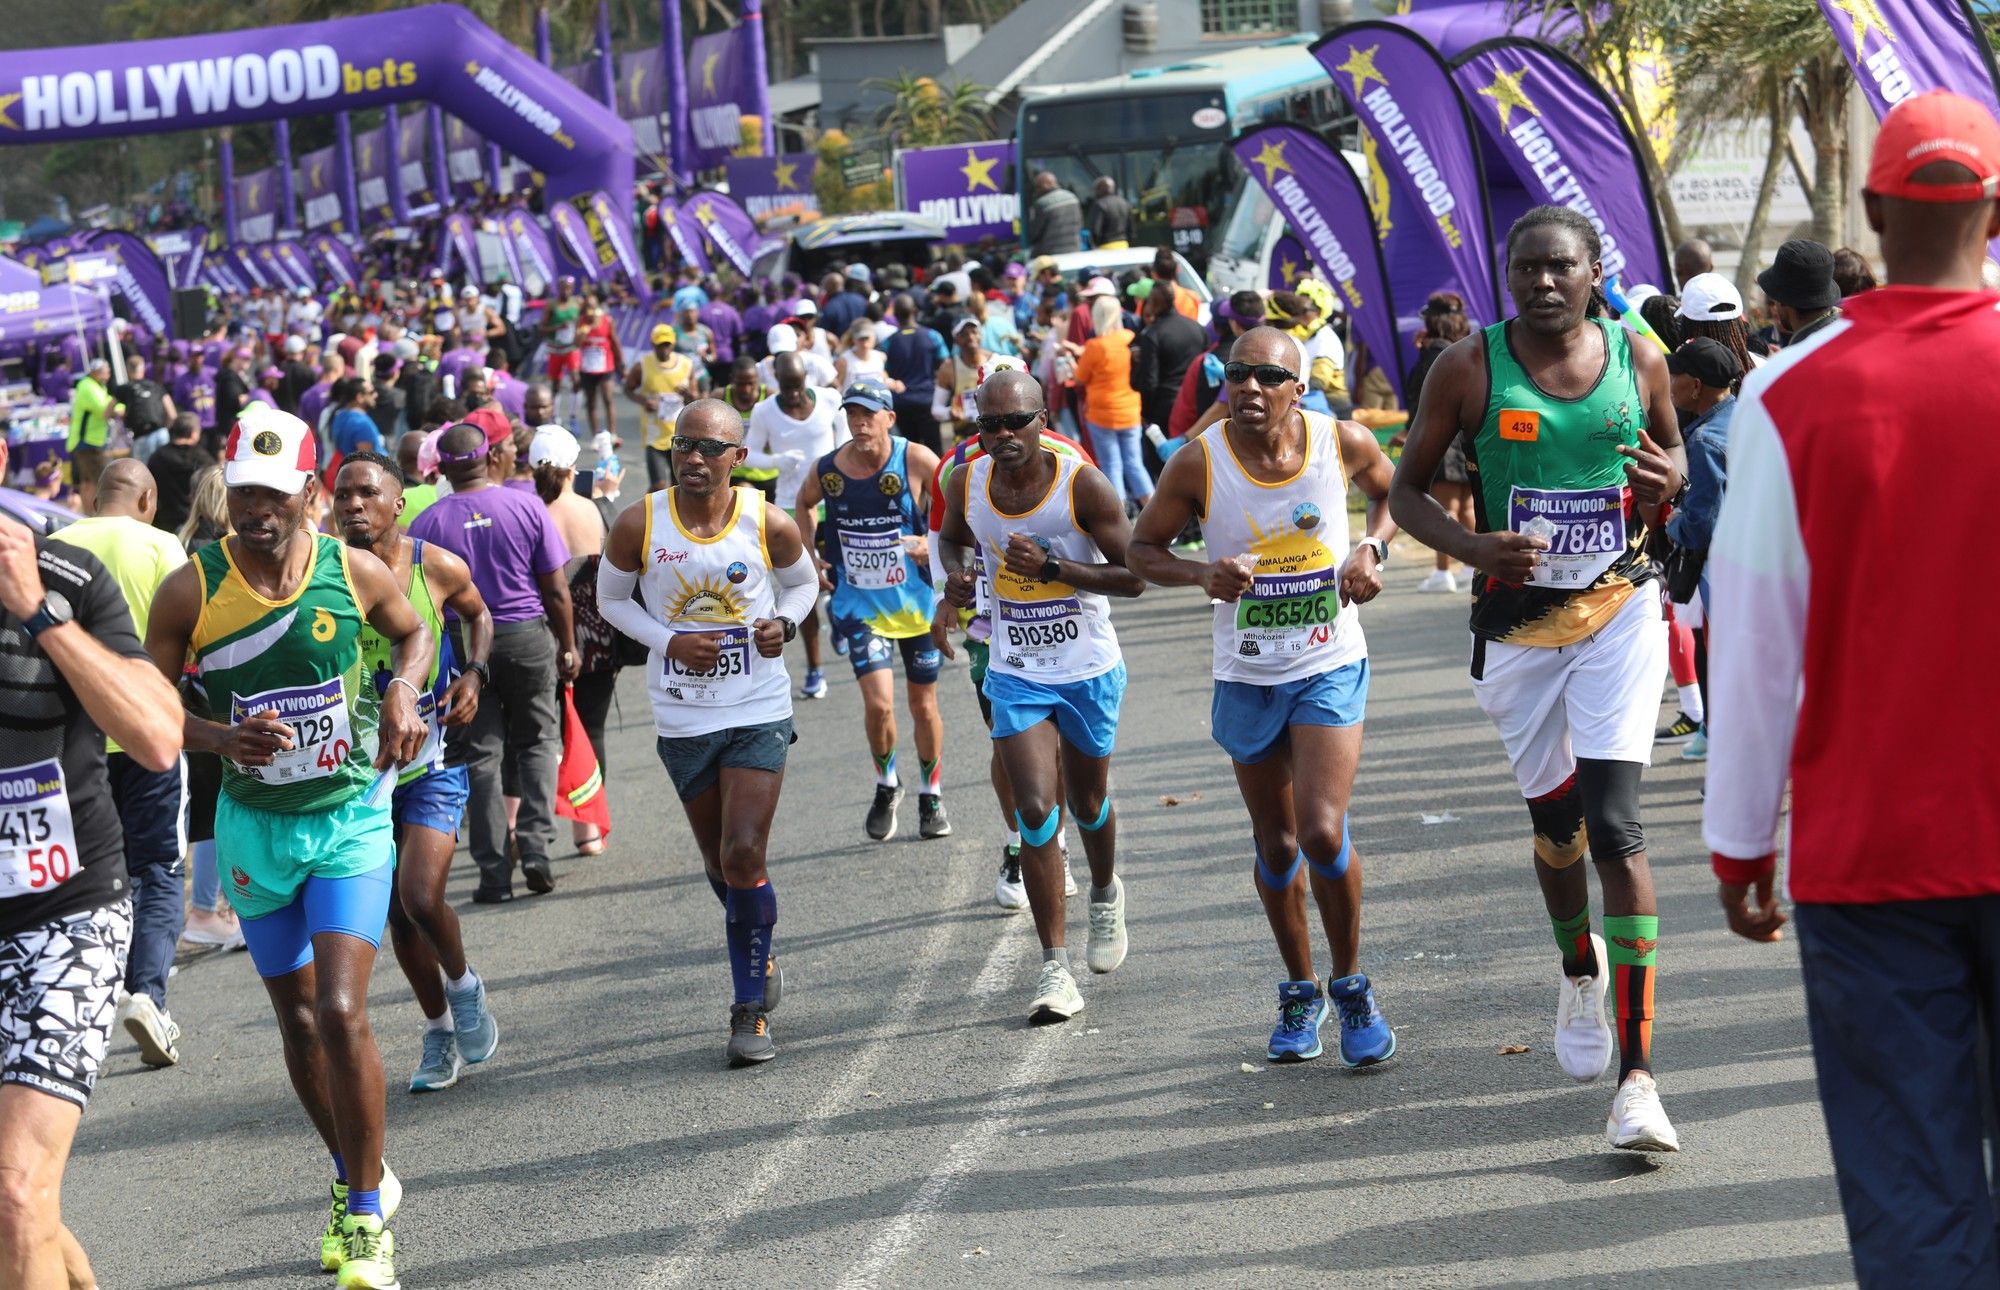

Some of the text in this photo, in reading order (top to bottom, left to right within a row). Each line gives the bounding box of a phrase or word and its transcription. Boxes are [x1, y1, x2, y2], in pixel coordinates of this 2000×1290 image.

[1512, 422, 1533, 433] 439
[1540, 521, 1616, 553] 7828
[847, 551, 898, 569] C52079
[1280, 565, 1297, 573] KZN
[886, 567, 905, 585] 40
[1246, 596, 1328, 628] C36526
[1008, 620, 1078, 646] B10380
[1244, 632, 1285, 641] Mthokozisi
[1242, 642, 1258, 650] ASA
[1291, 643, 1301, 651] 15
[668, 680, 707, 689] Thamsanqa
[317, 739, 350, 772] 40
[28, 844, 70, 888] 50
